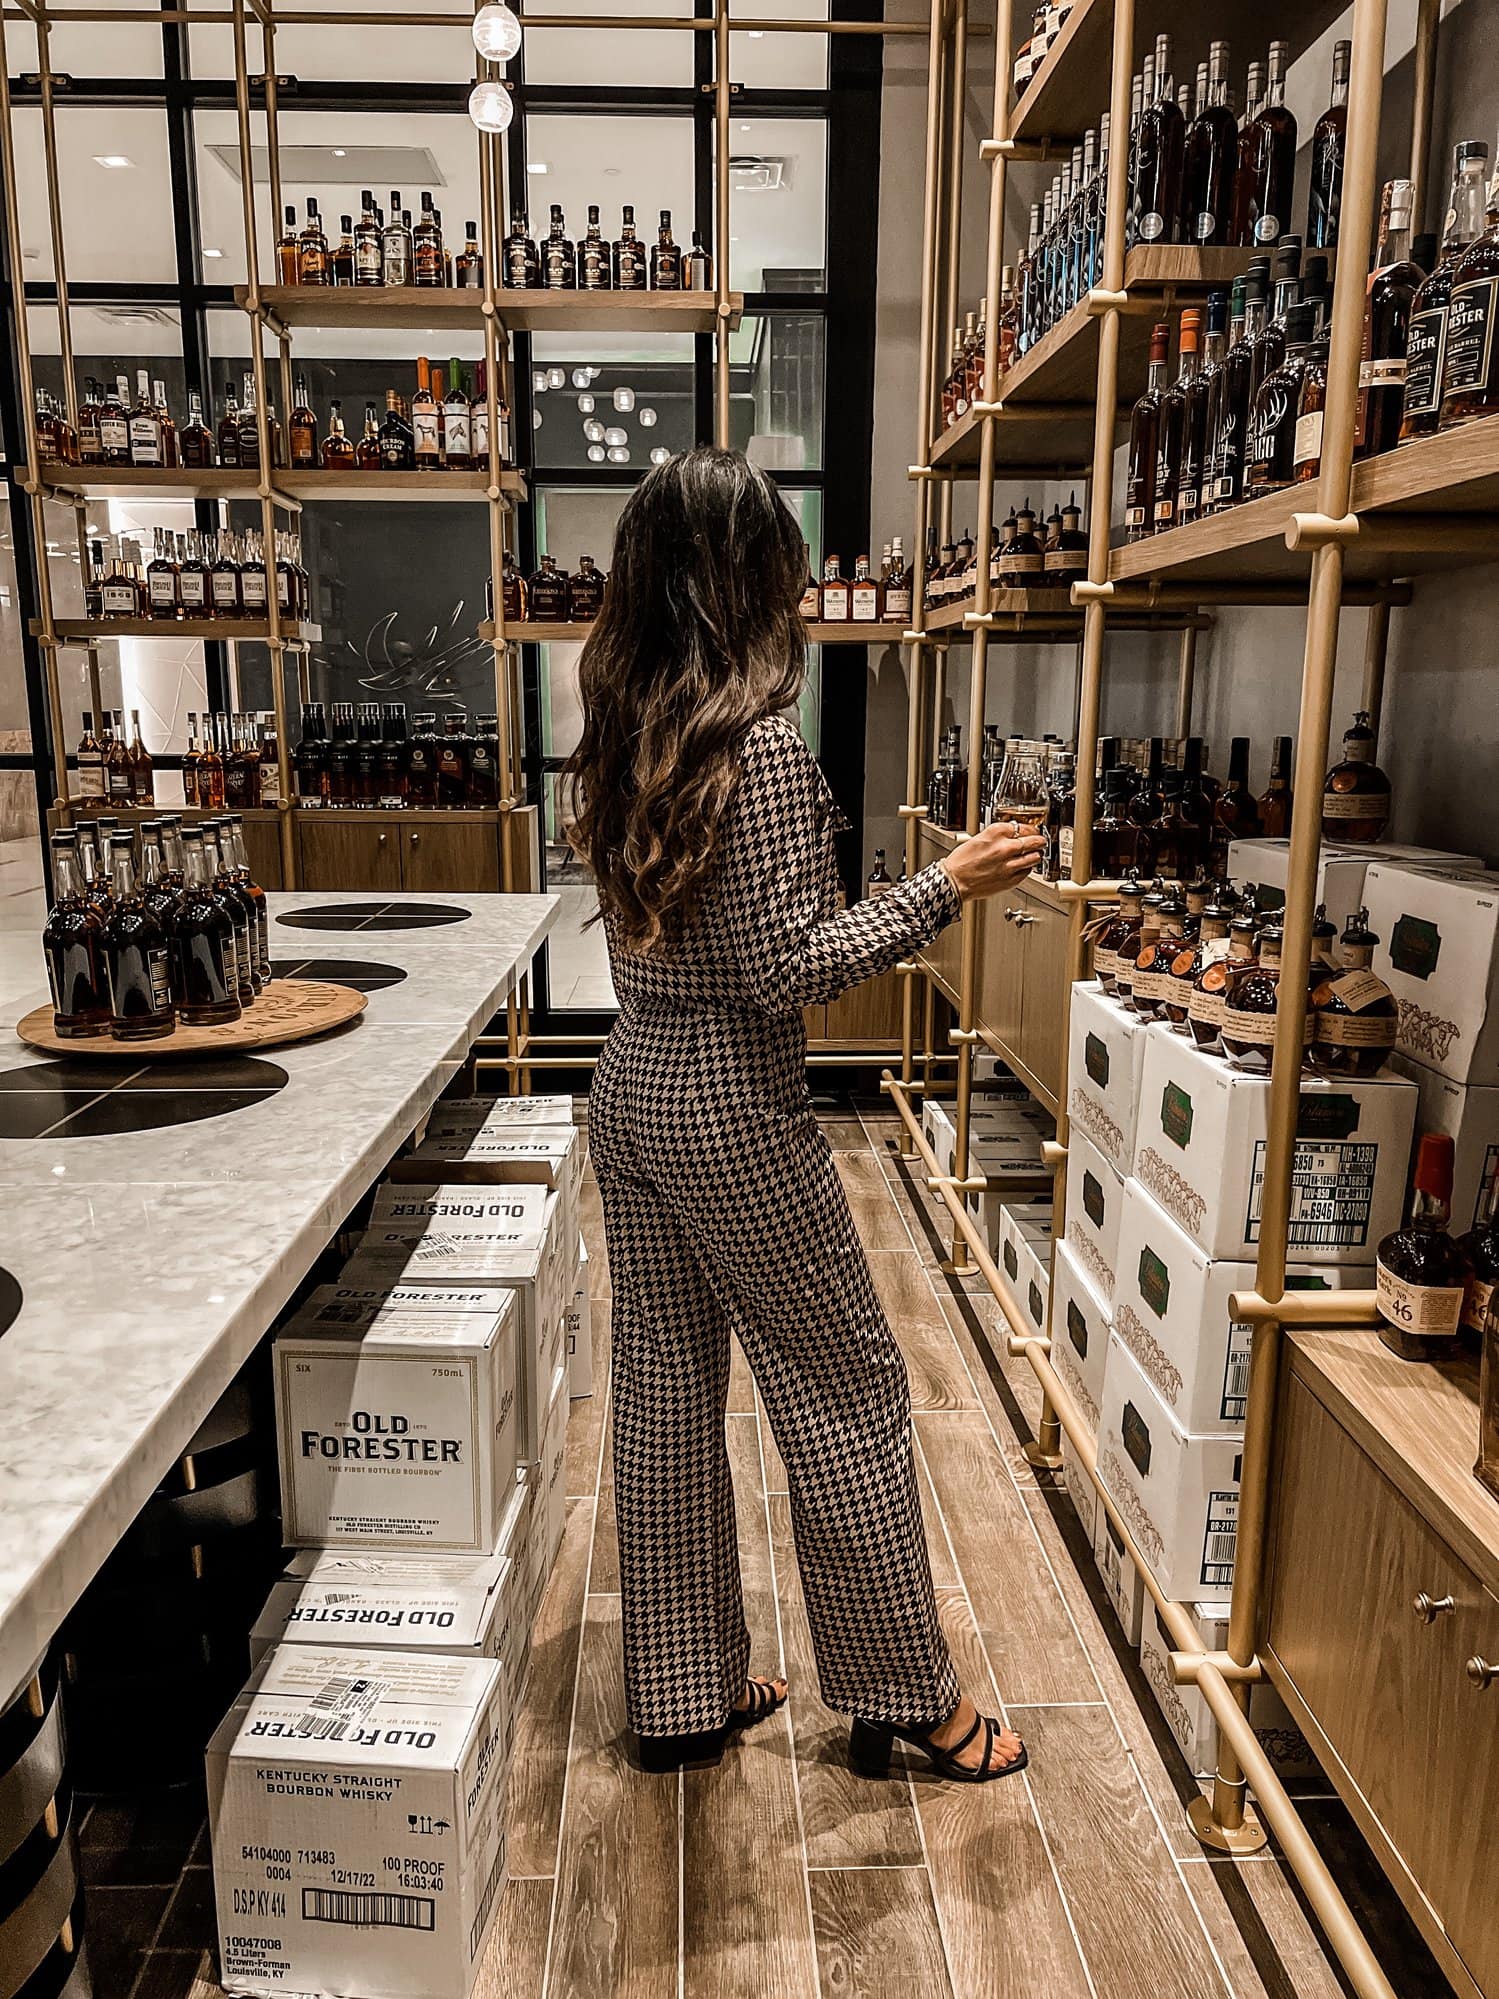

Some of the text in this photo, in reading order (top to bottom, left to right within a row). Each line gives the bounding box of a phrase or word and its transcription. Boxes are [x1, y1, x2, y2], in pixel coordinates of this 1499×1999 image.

[394, 1204, 525, 1218] OLD FORESTER
[452, 1233, 522, 1241] RESTER
[336, 1289, 484, 1301] OLD FORESTER
[1392, 1299, 1413, 1322] 46
[295, 1363, 312, 1373] SIX
[431, 1368, 464, 1377] 750mL
[352, 1411, 410, 1434] OLD
[300, 1430, 461, 1463] FORESTER
[328, 1465, 342, 1473] THE
[344, 1466, 365, 1474] FIRST
[367, 1467, 401, 1475] BOTTLED
[287, 1607, 455, 1628] OLD FORESTER
[384, 1730, 437, 1749] OLD
[256, 1769, 402, 1789] KENTUCKY STRAIGHT
[266, 1783, 393, 1801] BOURBON WHISKY
[241, 1846, 336, 1865] 54104000 713483
[382, 1856, 445, 1876] 100 PROOF
[266, 1866, 375, 1887] 0004 12/17/22
[398, 1873, 444, 1891] 16:03:40
[257, 1890, 270, 1916] KY
[271, 1891, 286, 1918] 414
[225, 1936, 282, 1951] 10047008
[225, 1949, 266, 1958] 4.5 Liters
[226, 1957, 291, 1970] Brown-Forman
[227, 1966, 284, 1979] Louisville, KY
